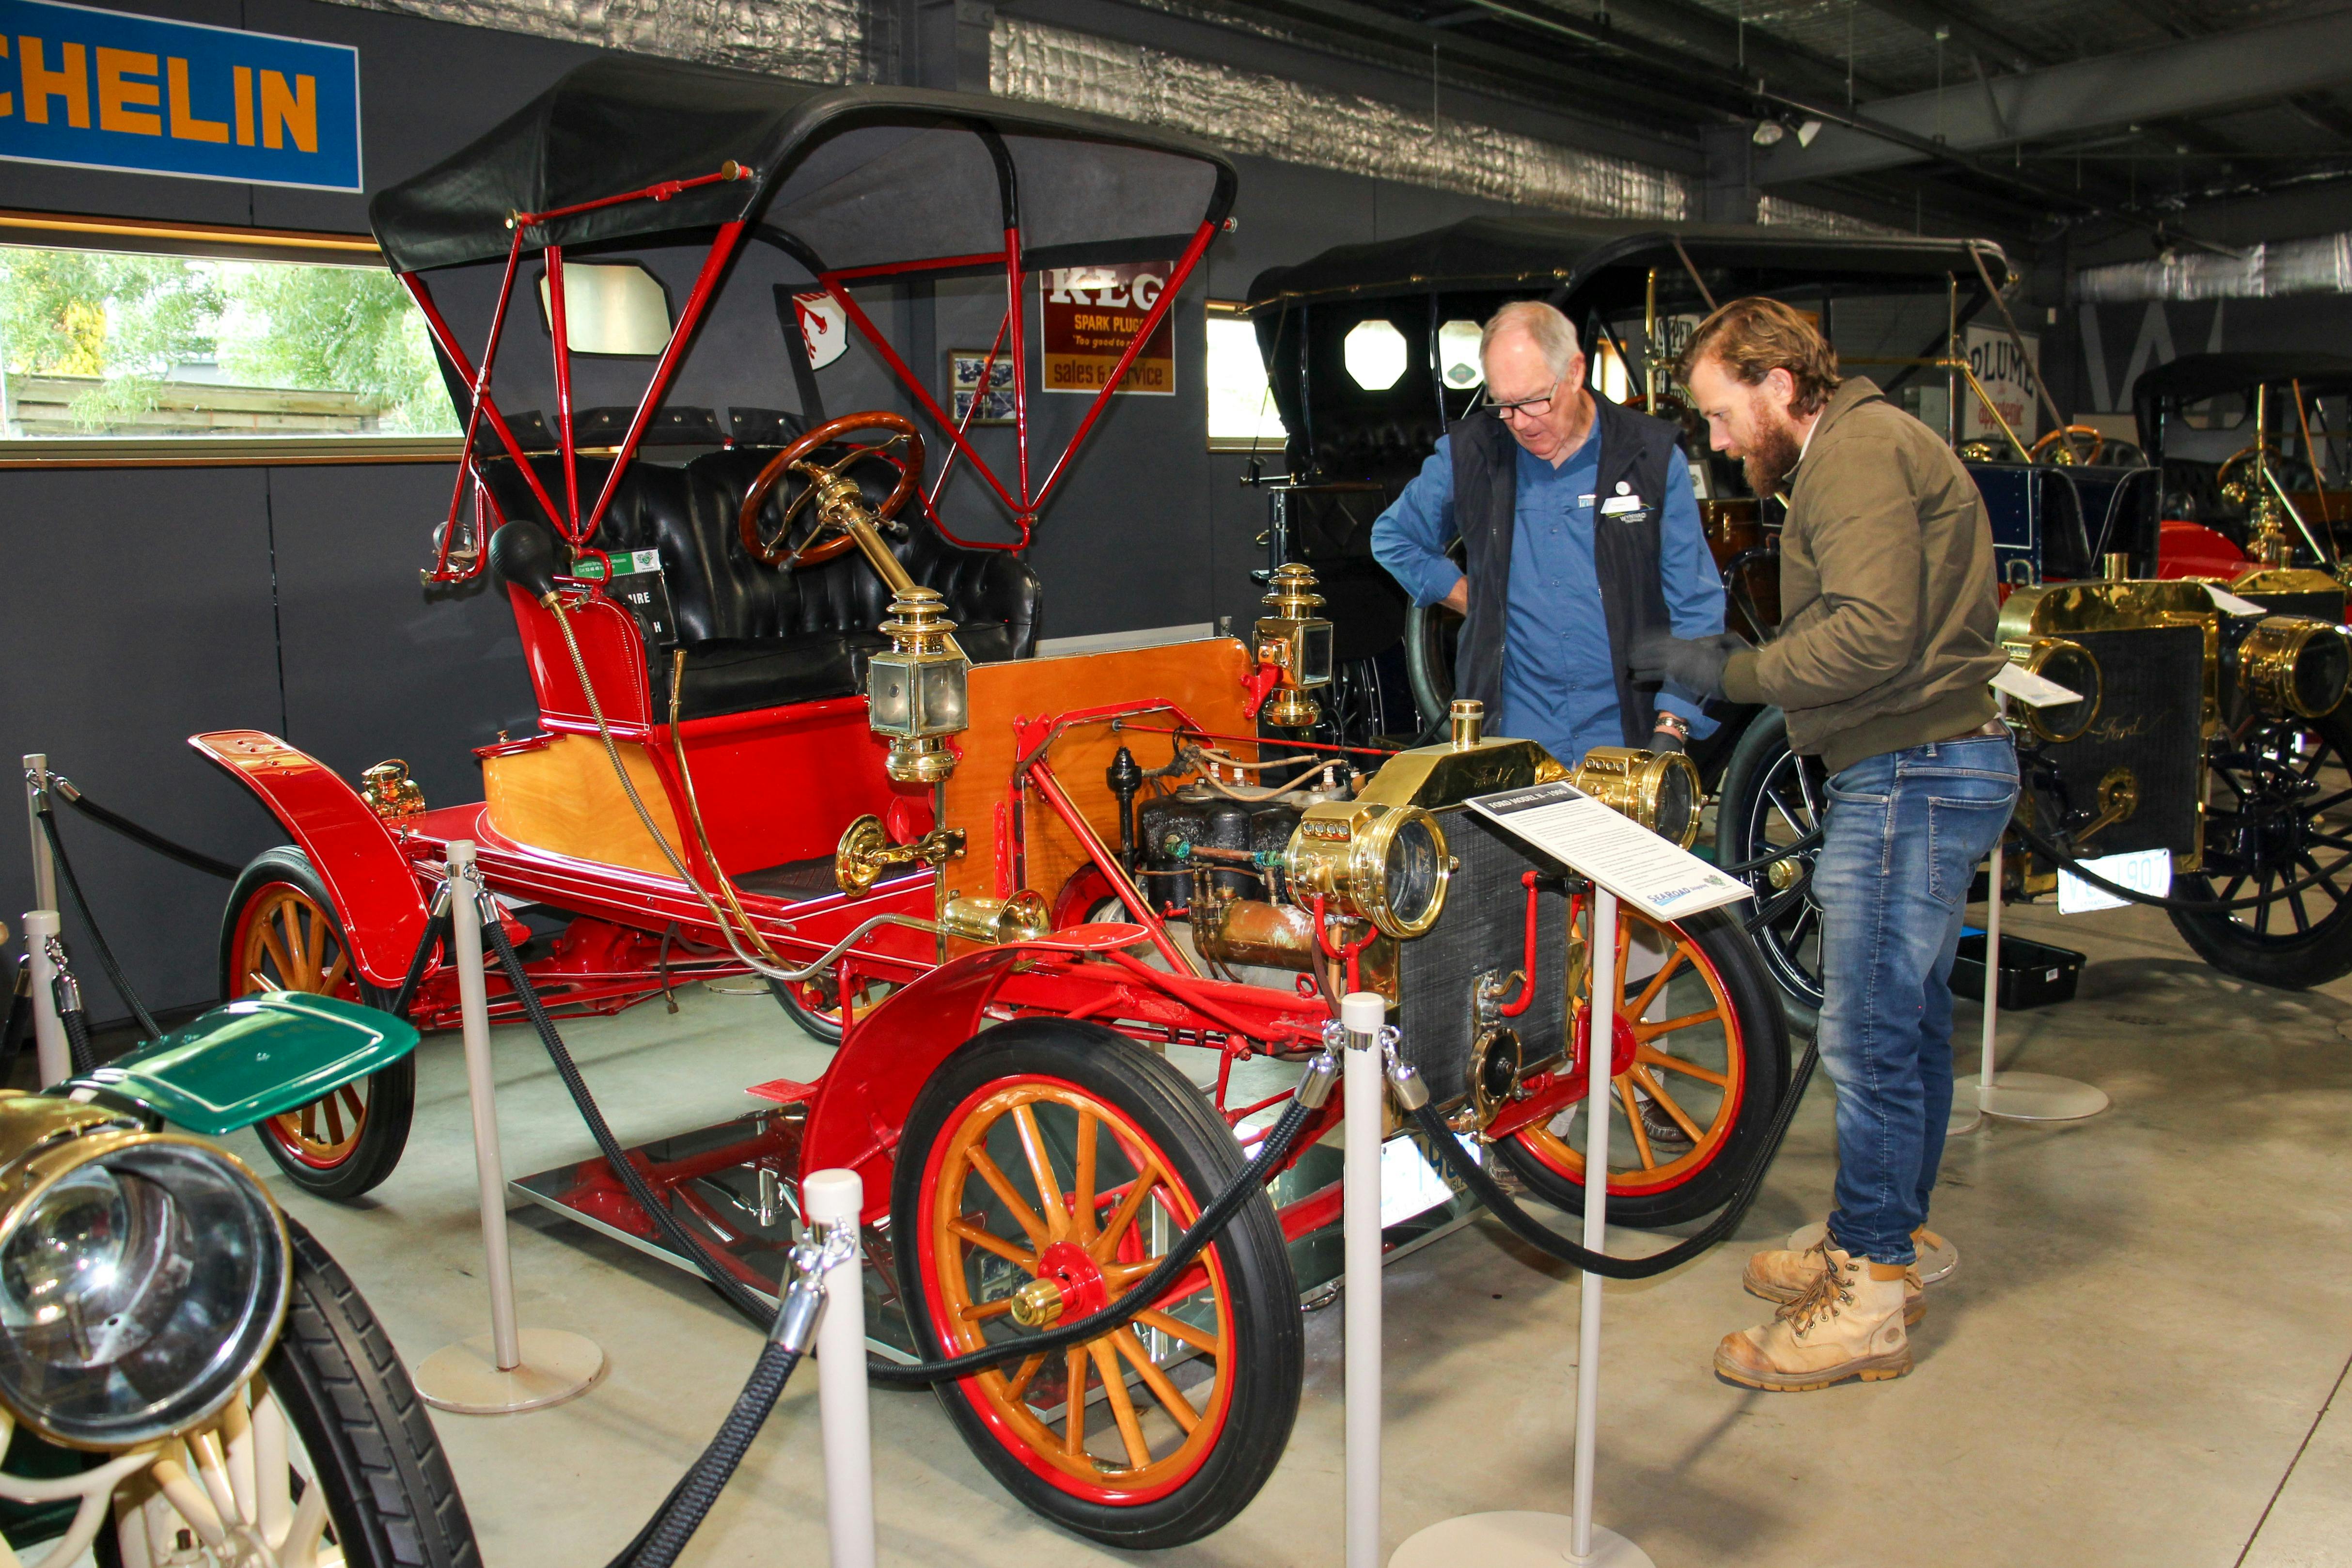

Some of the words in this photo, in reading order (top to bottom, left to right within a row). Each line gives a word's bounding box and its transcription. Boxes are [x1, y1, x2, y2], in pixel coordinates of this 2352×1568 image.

[0, 34, 318, 153] HELIN
[1074, 314, 1110, 331] SPARK
[1113, 316, 1145, 332] PLUG
[1093, 338, 1114, 348] good
[1054, 360, 1093, 384] sales
[1488, 799, 1512, 809] FORD
[1511, 795, 1539, 805] MODEL
